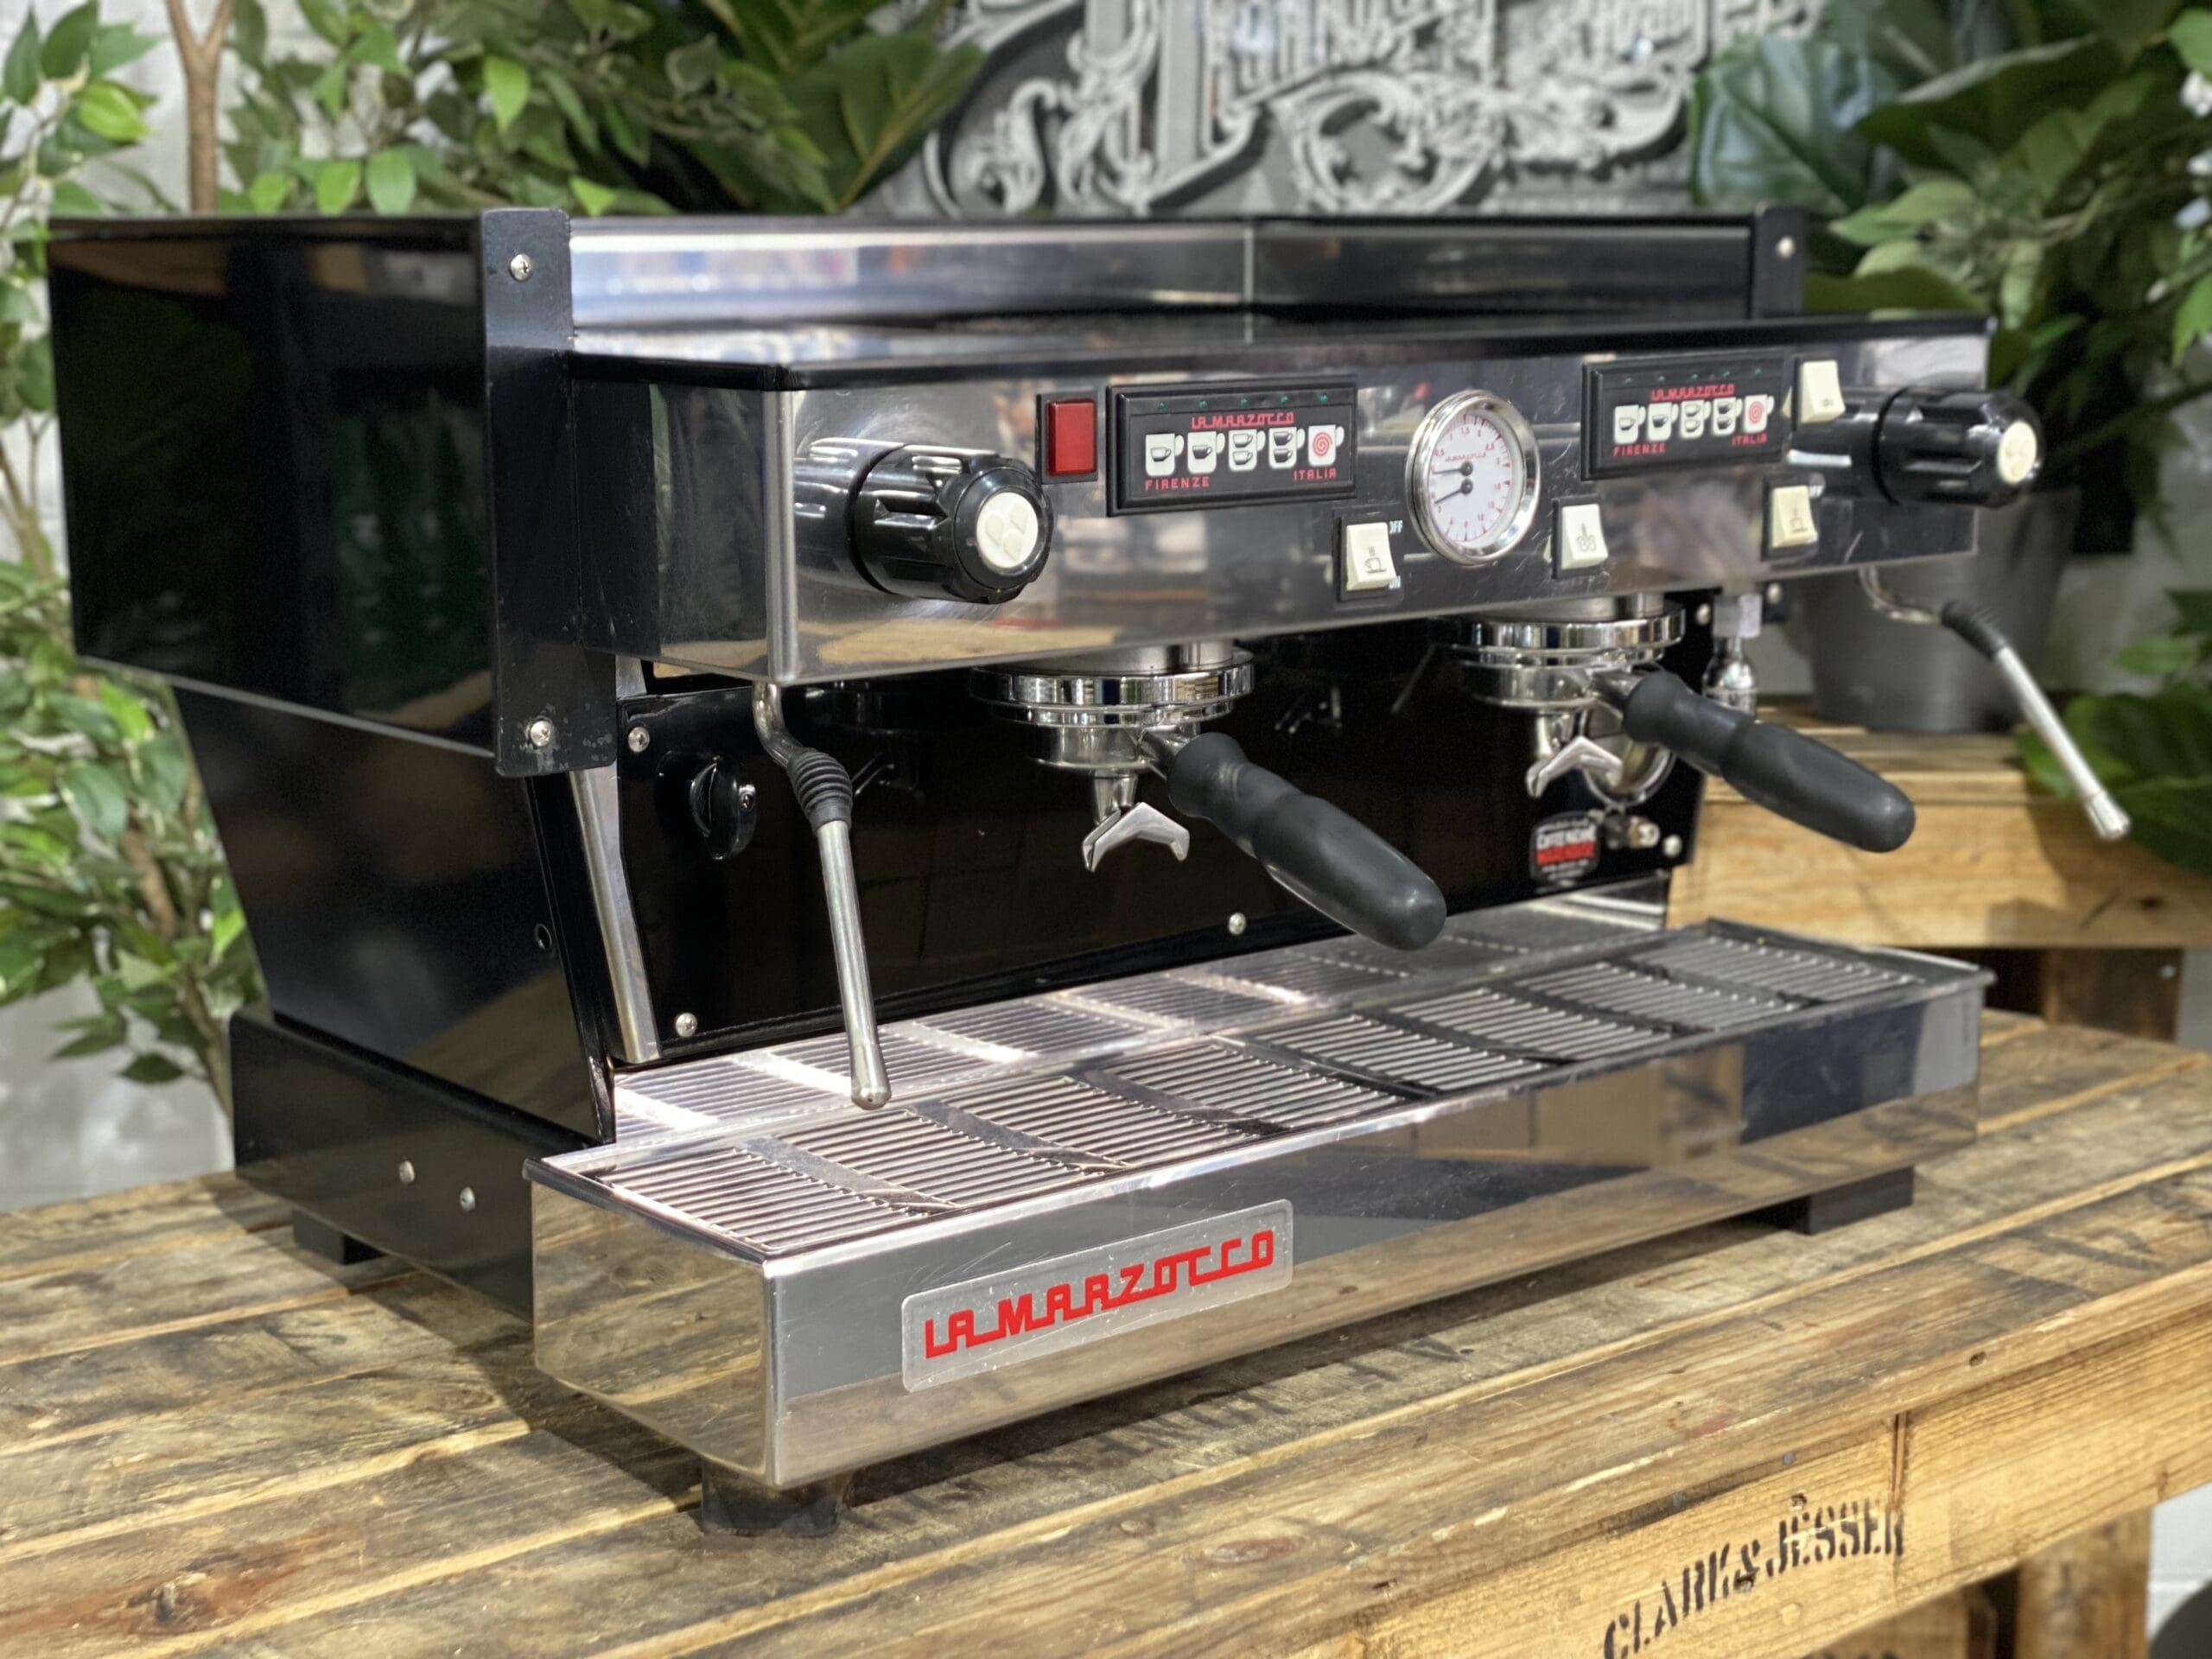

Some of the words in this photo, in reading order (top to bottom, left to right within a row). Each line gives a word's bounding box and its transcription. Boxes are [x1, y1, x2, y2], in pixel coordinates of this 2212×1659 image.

[1192, 416, 1208, 429] LA
[1213, 411, 1294, 429] MARZOCCO
[1731, 433, 1768, 446] ITALIA
[1612, 442, 1666, 456] FIRENZE
[1294, 467, 1337, 481] ITALIA
[1145, 475, 1211, 491] FIRENZE
[925, 1309, 975, 1359] LA
[996, 1230, 1274, 1338] MARZOCCO
